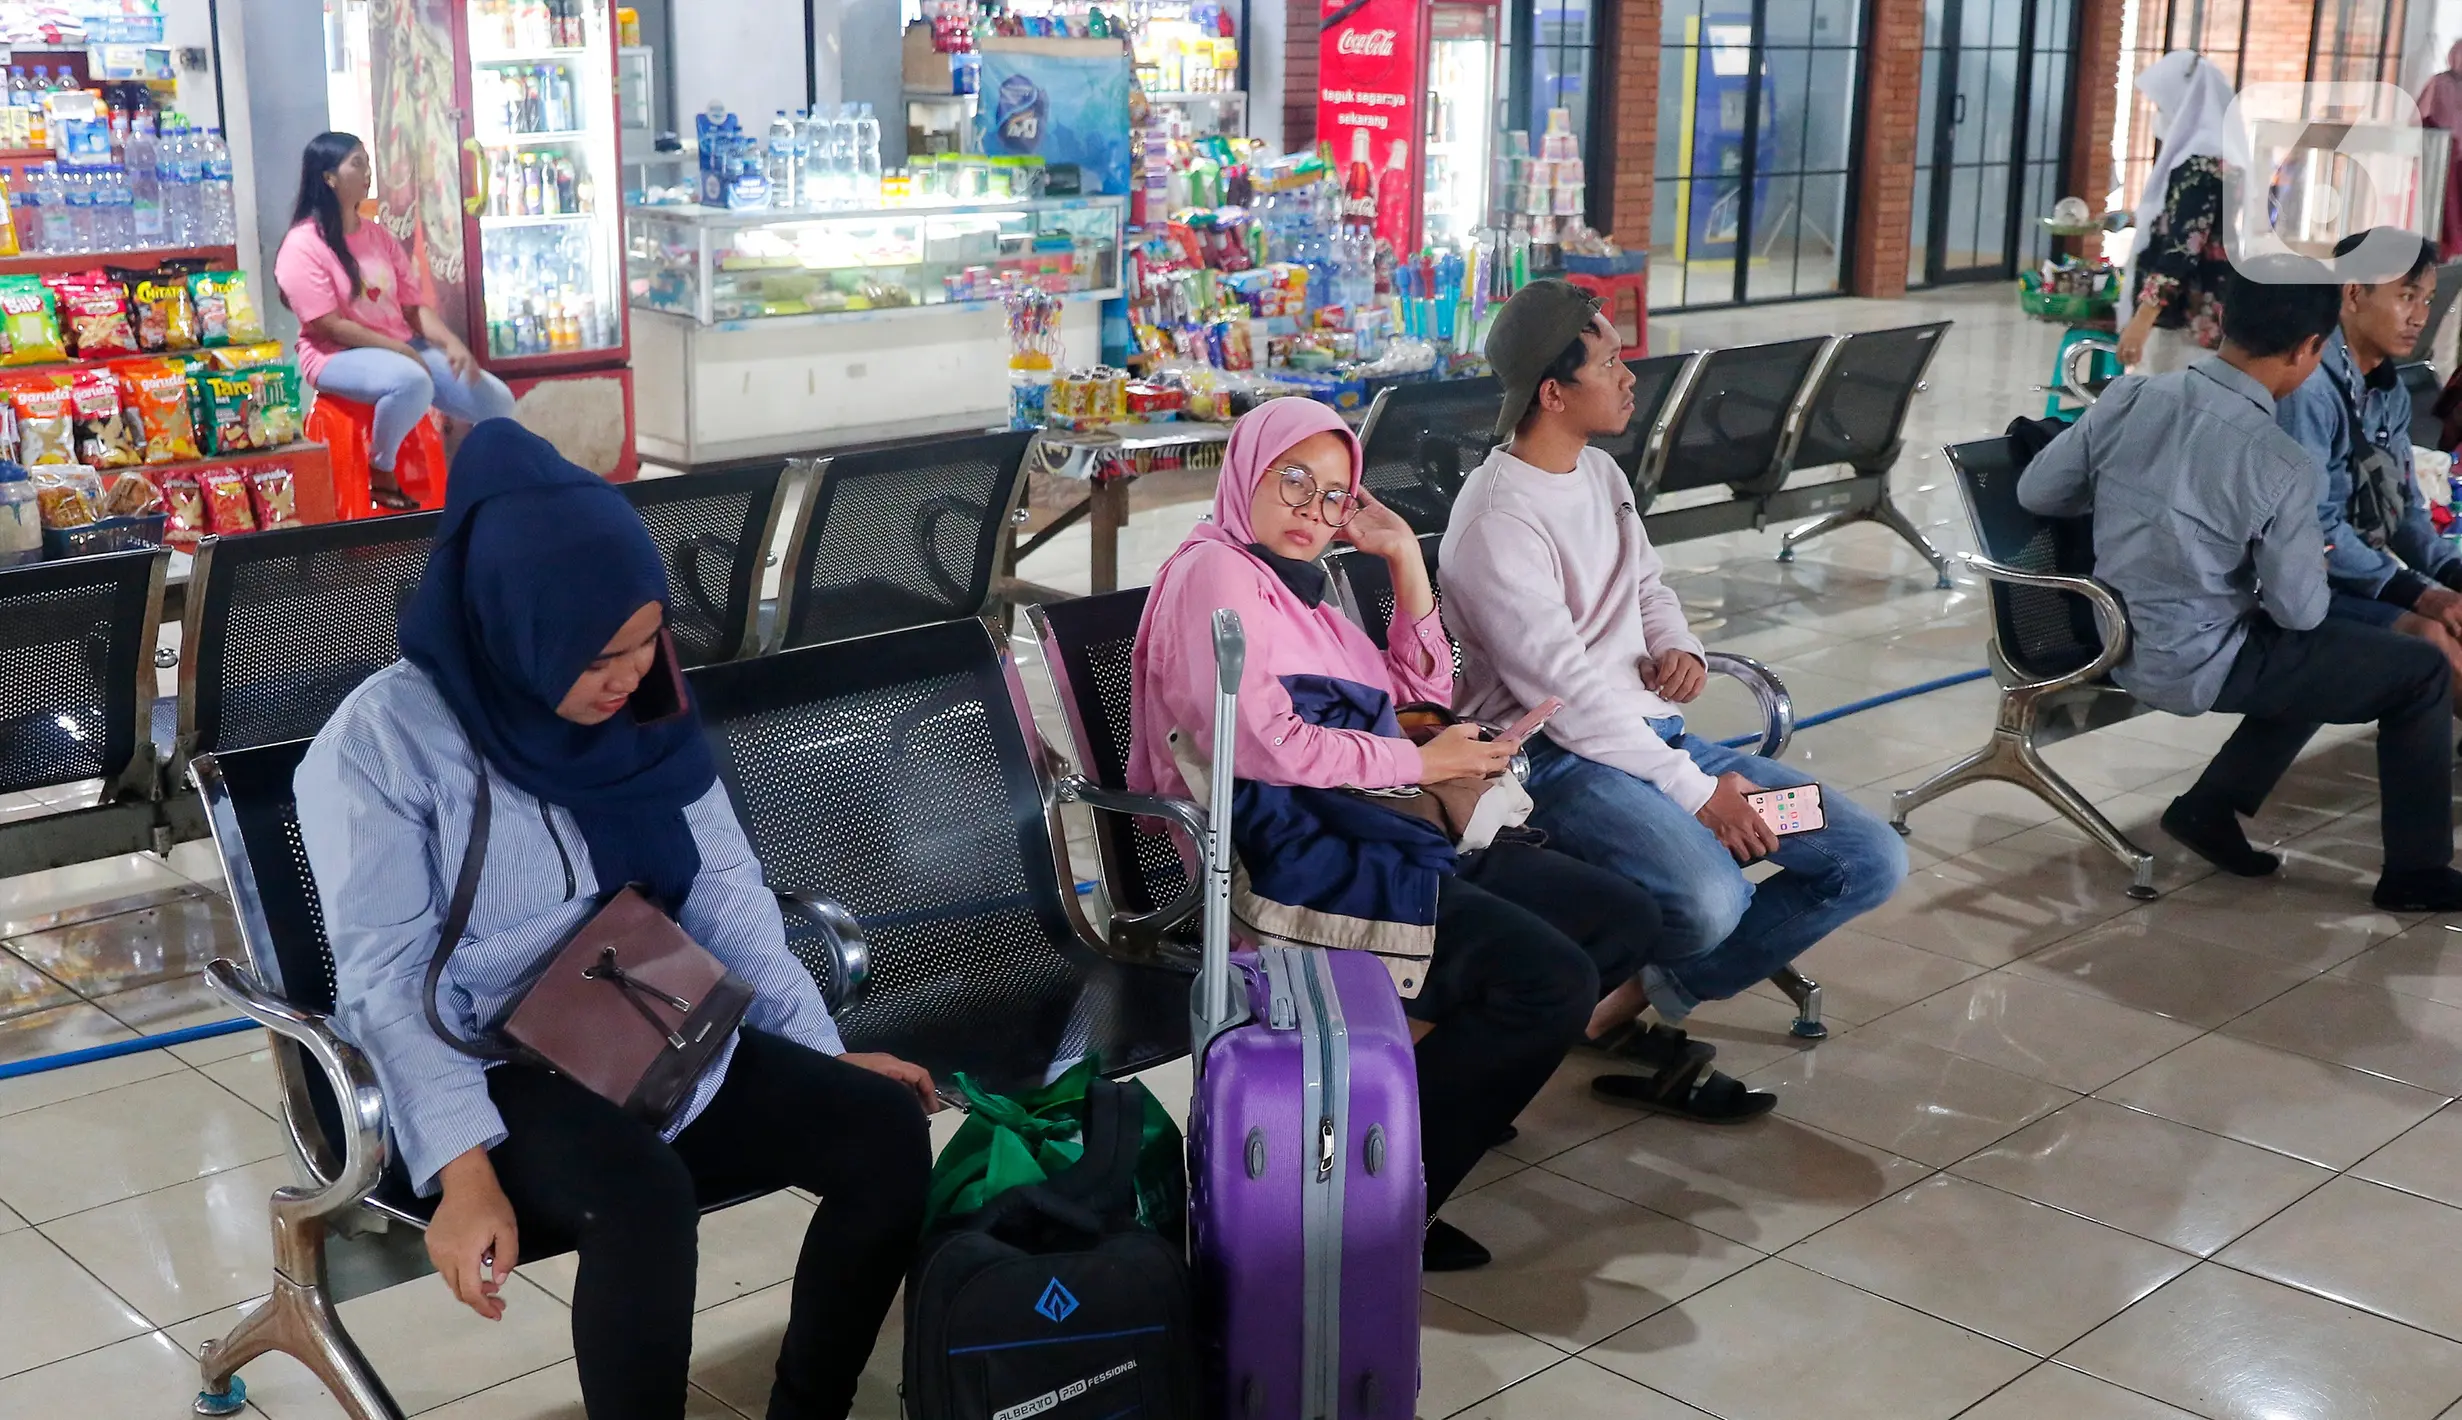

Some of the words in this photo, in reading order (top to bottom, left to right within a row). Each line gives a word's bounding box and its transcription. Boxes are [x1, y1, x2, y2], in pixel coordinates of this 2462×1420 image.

[1337, 27, 1397, 56] Coca-Cola
[1337, 111, 1388, 130] sekarang
[17, 386, 71, 405] garuda
[207, 377, 253, 397] Taro
